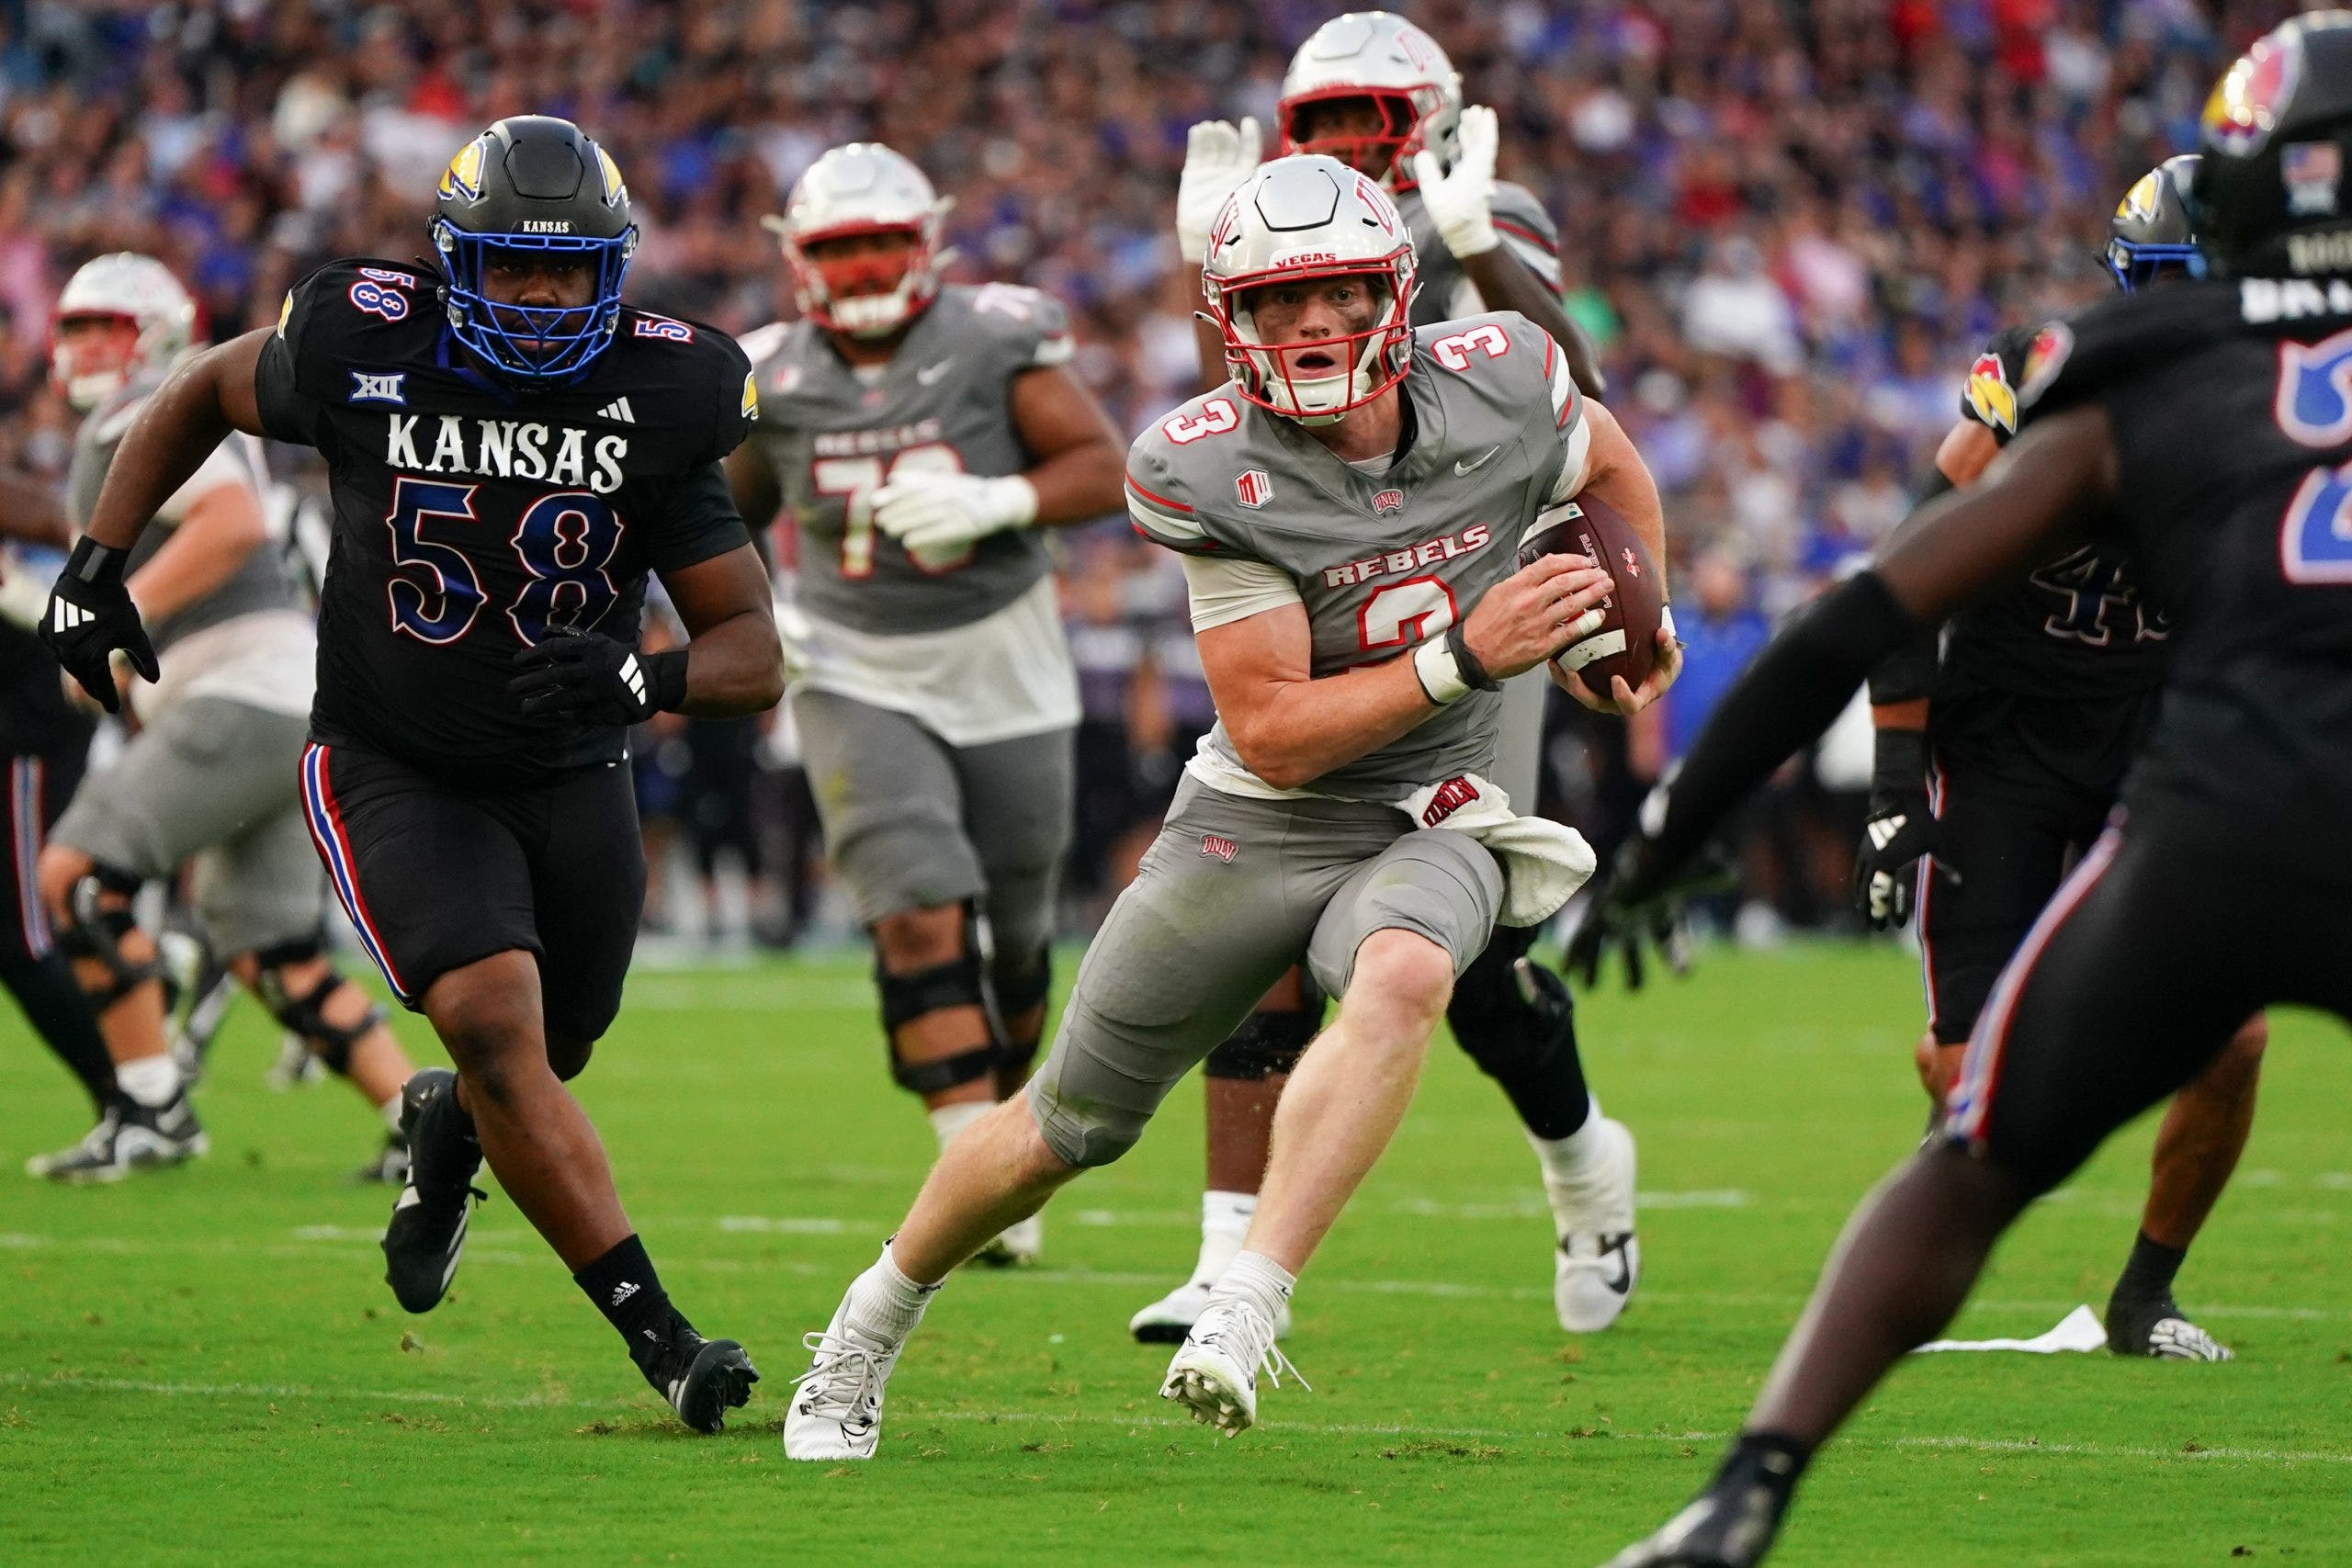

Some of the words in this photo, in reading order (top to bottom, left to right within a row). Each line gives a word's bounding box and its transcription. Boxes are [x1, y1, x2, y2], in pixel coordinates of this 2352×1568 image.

[523, 220, 570, 233] KANSAS
[1274, 253, 1337, 268] VEGAS
[1431, 323, 1510, 372] 3
[1162, 398, 1240, 446] 3
[385, 413, 628, 493] KANSAS
[1374, 491, 1399, 512] UNLV
[384, 473, 626, 649] 58
[1322, 523, 1491, 589] REBELS
[1422, 775, 1480, 828] UNLV
[1202, 836, 1235, 860] UNLV
[612, 1283, 640, 1306] adidas
